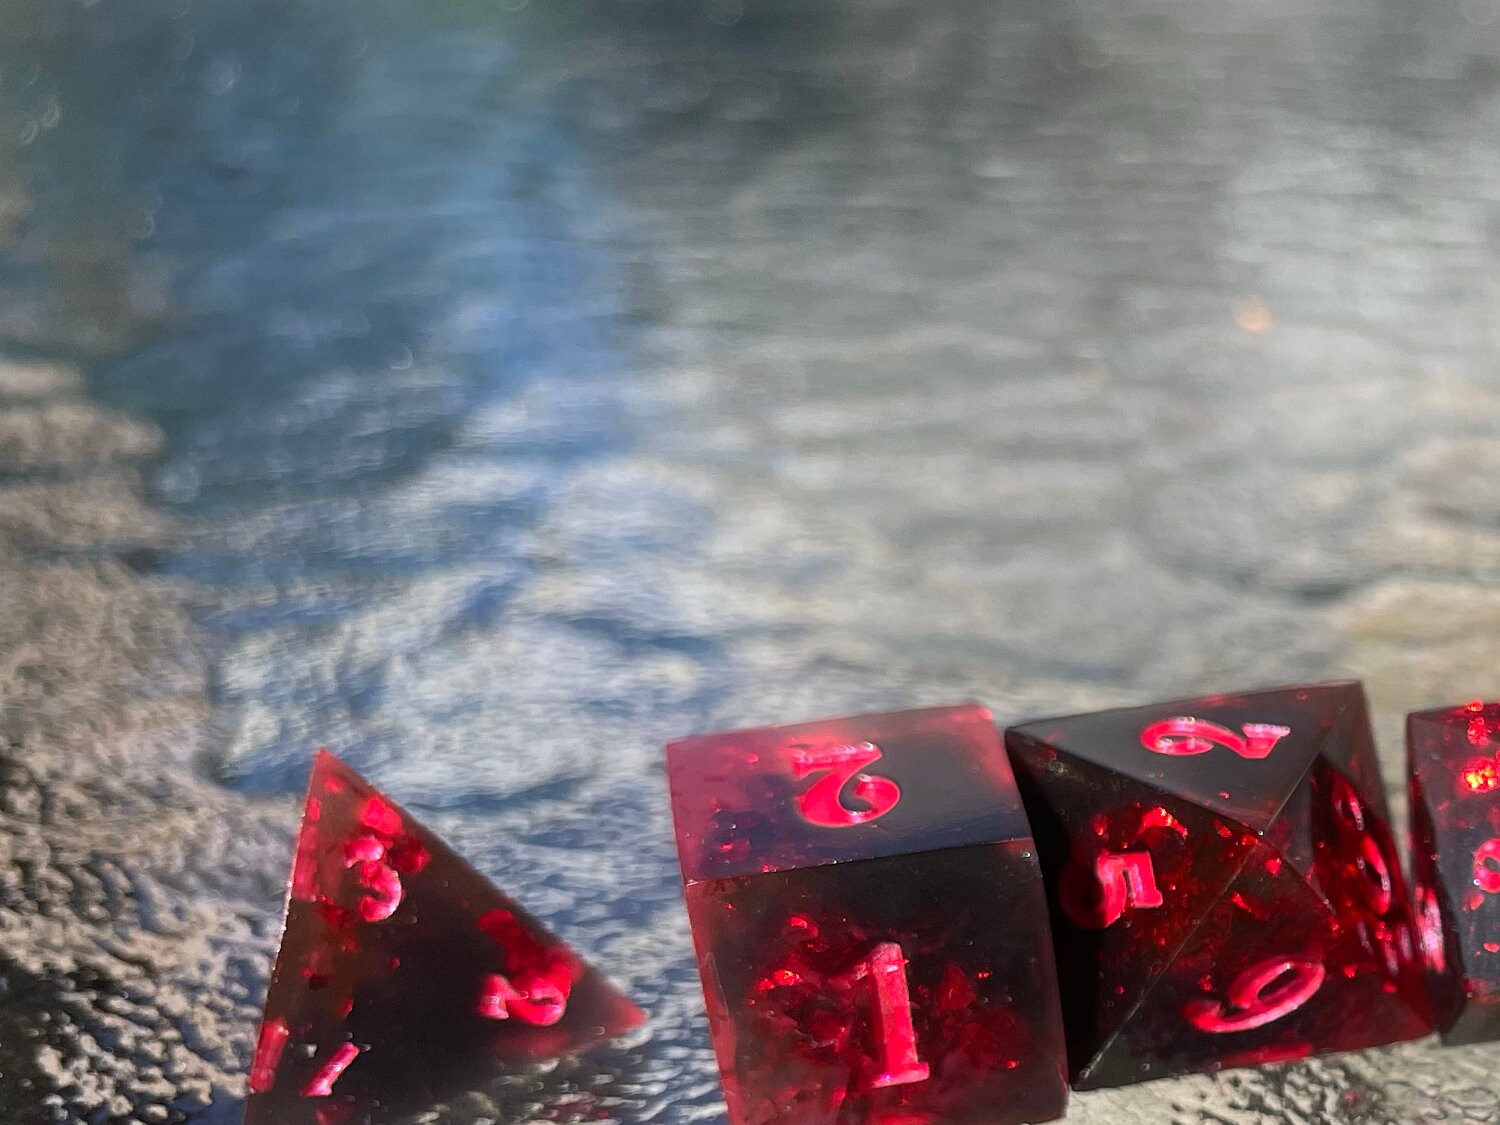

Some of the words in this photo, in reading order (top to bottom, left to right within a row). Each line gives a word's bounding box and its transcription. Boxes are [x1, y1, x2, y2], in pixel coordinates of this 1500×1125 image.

[1138, 715, 1292, 760] 2
[787, 741, 901, 829] 2
[344, 835, 404, 923] 3
[854, 941, 932, 1089] 1
[302, 1041, 361, 1097] 1
